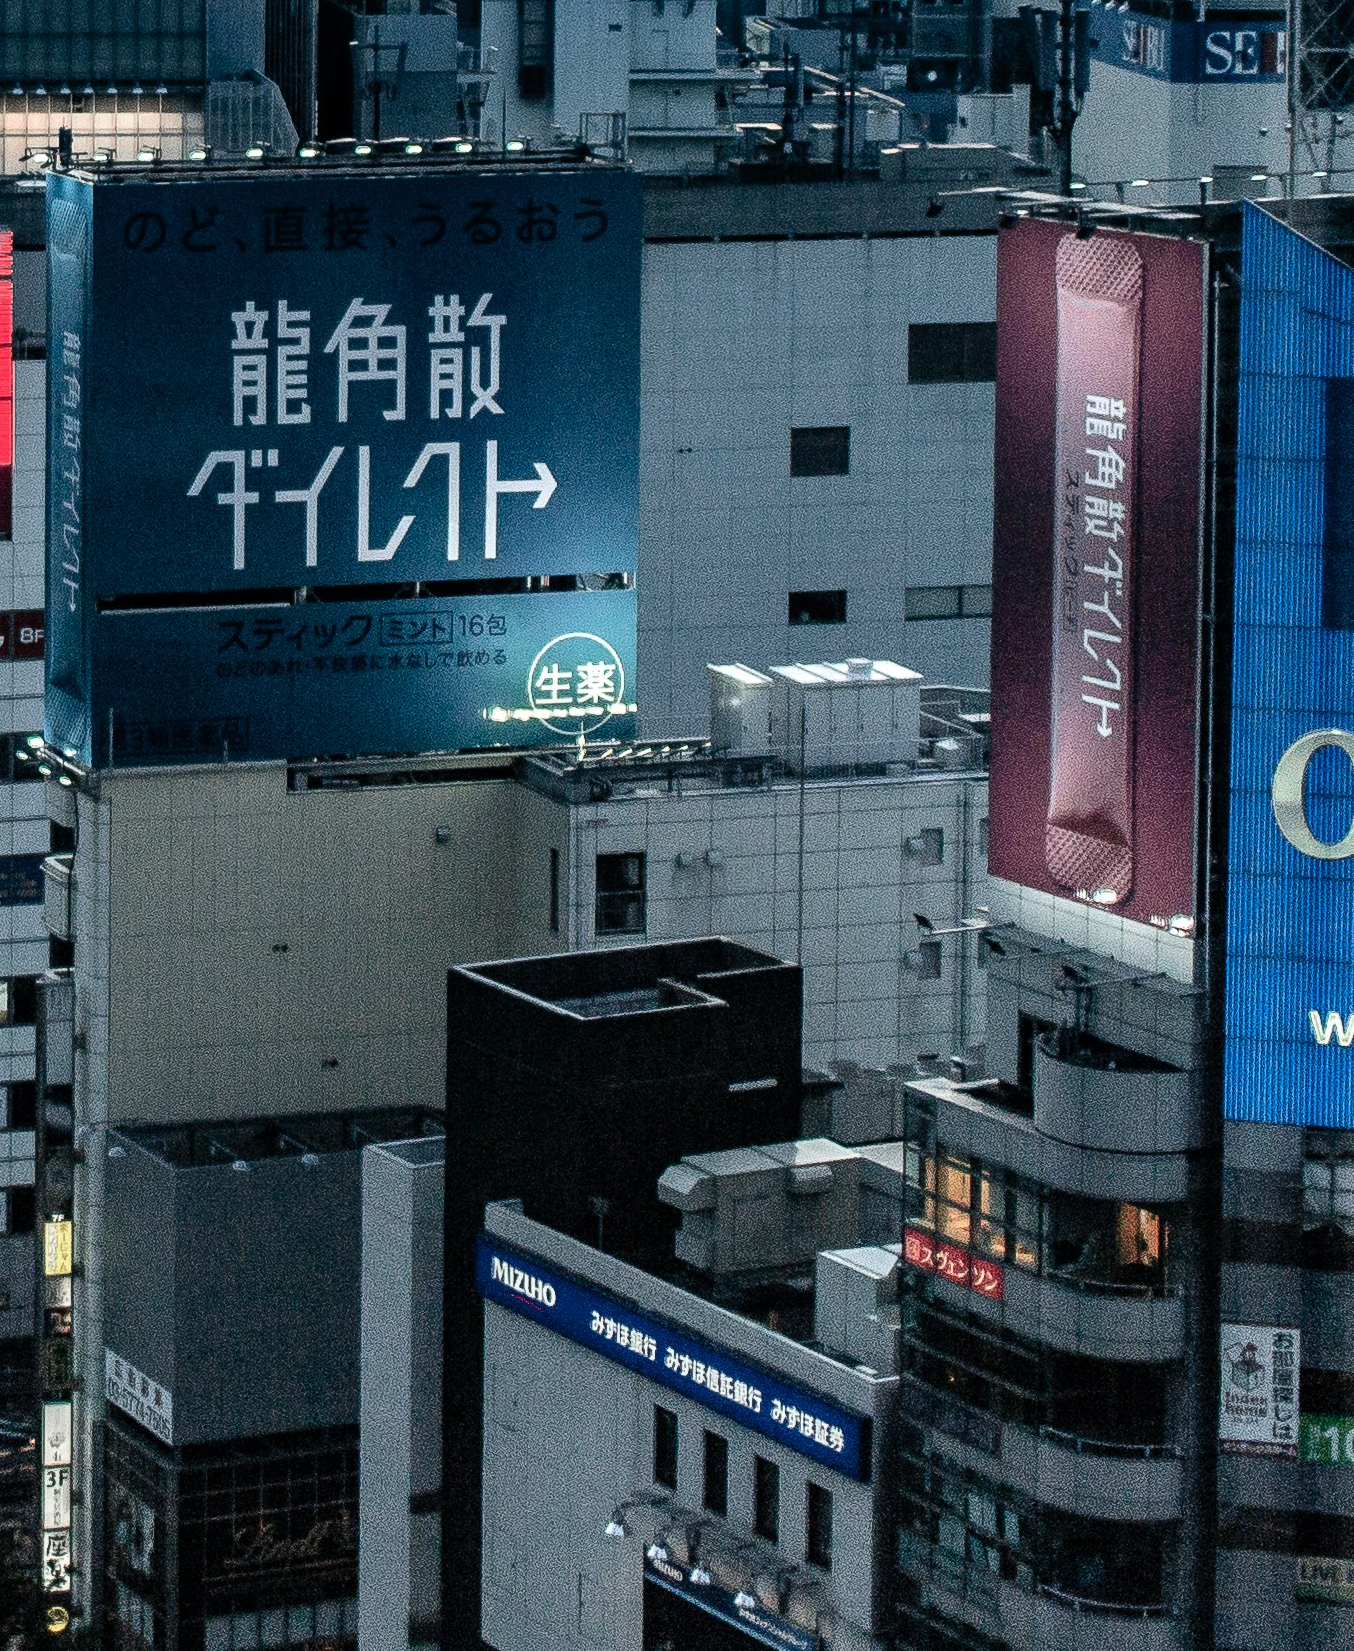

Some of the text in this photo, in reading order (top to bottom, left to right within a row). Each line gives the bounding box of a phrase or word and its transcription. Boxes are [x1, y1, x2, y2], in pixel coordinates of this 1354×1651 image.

[122, 195, 610, 253] のど、直接、うるおう
[230, 292, 508, 427] 龍角散
[186, 439, 559, 571] ダイレクト
[217, 614, 509, 653] スティック ミント 16包
[534, 661, 616, 704] 生薬
[51, 1214, 66, 1222] 7F
[491, 1254, 845, 1454] MIZUHO みずほ銀行 みずほ信託銀行 みずほ証券
[46, 1470, 69, 1488] 3F
